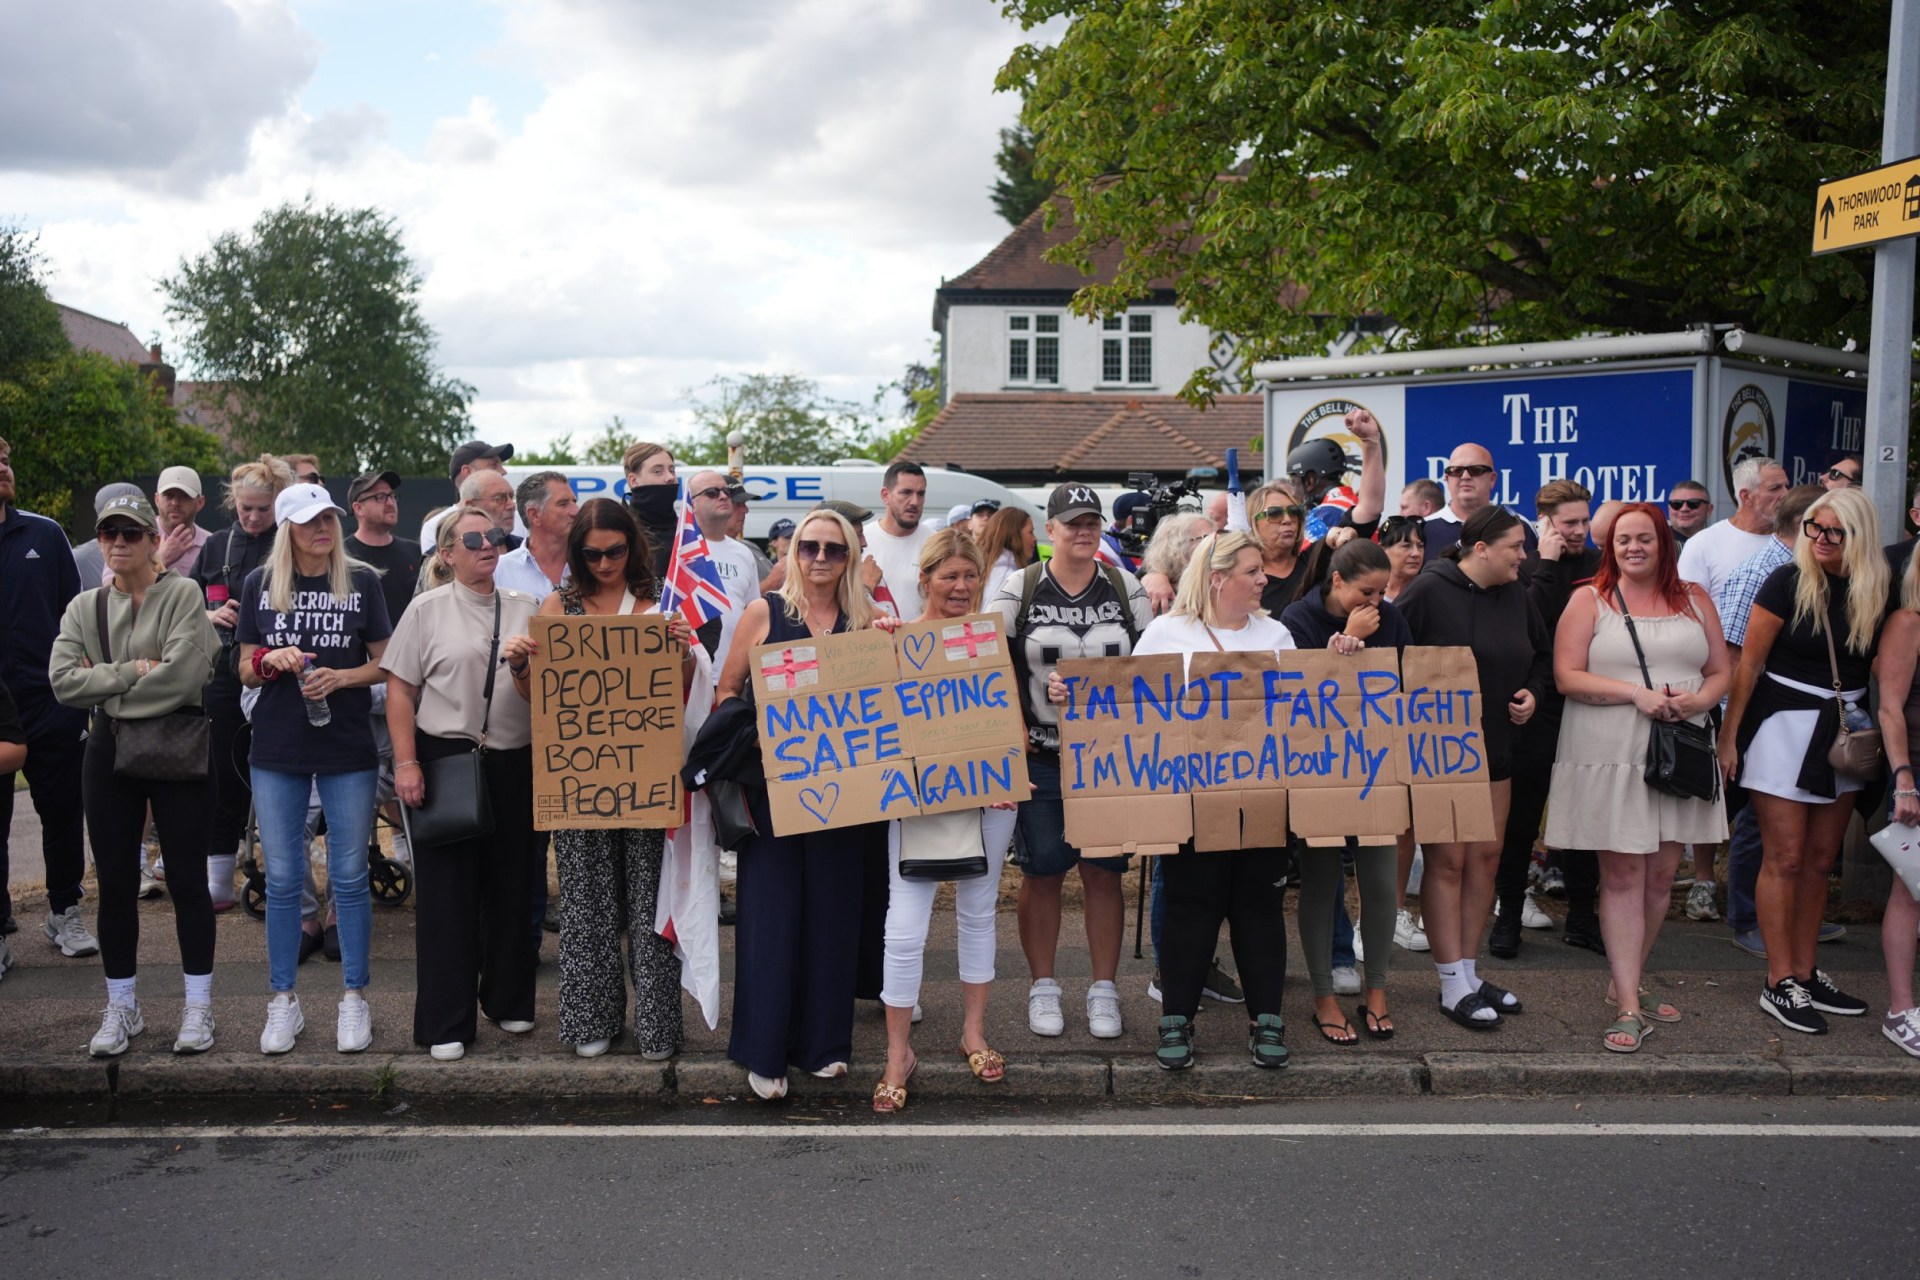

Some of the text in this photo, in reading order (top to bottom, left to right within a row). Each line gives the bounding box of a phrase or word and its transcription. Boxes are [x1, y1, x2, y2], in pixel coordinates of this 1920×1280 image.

[1838, 182, 1901, 212] THORNWOOD
[1853, 210, 1879, 231] PARK
[1301, 410, 1320, 428] THE
[1320, 402, 1343, 417] BELL
[1503, 393, 1578, 445] THE
[1830, 401, 1861, 452] THE
[1883, 447, 1894, 461] 2
[568, 476, 825, 501] PICE
[1426, 452, 1666, 505] BL HOTEL
[266, 632, 352, 648] NEW YORK
[274, 611, 344, 631] & FITCH
[547, 623, 679, 663] BRITISH
[541, 667, 673, 714] PEOPLE
[766, 672, 1008, 737] MAKE EPPING
[1062, 671, 1474, 729] I'M NOT FAR RIGHT
[556, 706, 676, 741] BEFORE
[545, 743, 644, 773] BOAT
[775, 723, 902, 781] SAFE
[1070, 739, 1120, 790] I'M
[1343, 729, 1389, 800] My
[1408, 731, 1482, 778] KIDS
[560, 775, 676, 817] PEOPLE!
